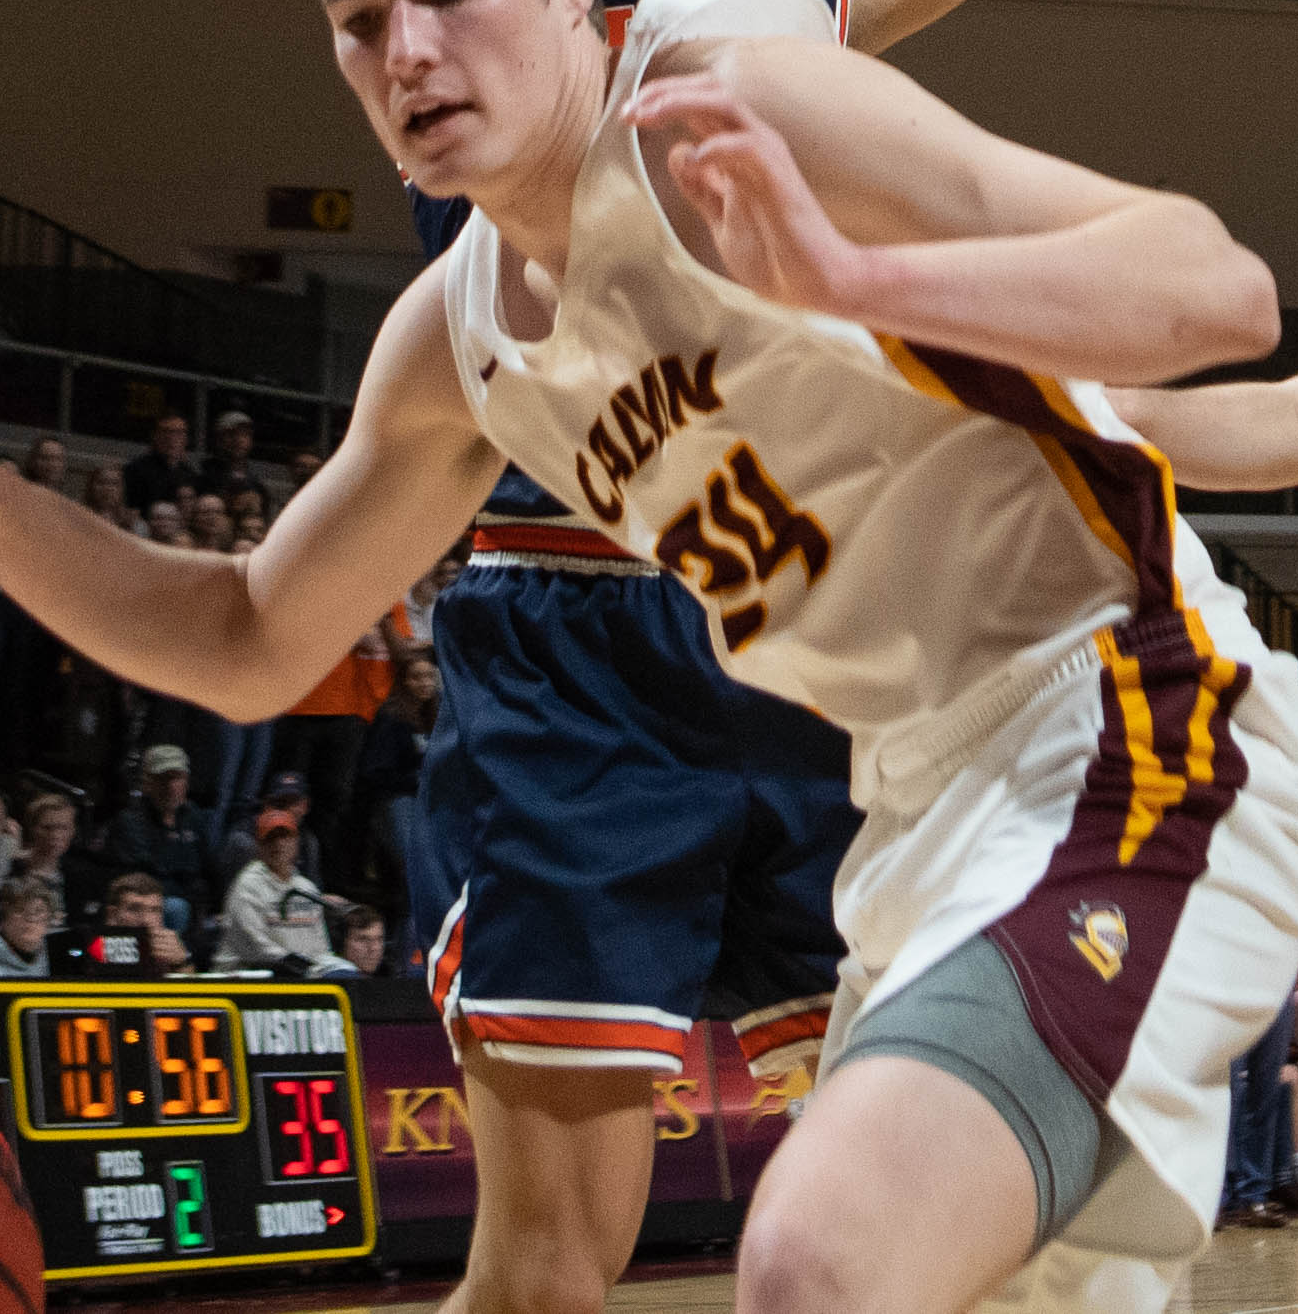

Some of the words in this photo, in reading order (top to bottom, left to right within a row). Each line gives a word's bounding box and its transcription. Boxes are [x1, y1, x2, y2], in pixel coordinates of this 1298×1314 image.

[576, 350, 725, 524] CALVIN
[57, 1016, 230, 1119] 10:56
[242, 1009, 348, 1055] VISITOR
[273, 1079, 350, 1177] 35
[84, 1183, 166, 1222] PERIOD
[170, 1167, 204, 1247] 2
[255, 1199, 327, 1237] BONUS
